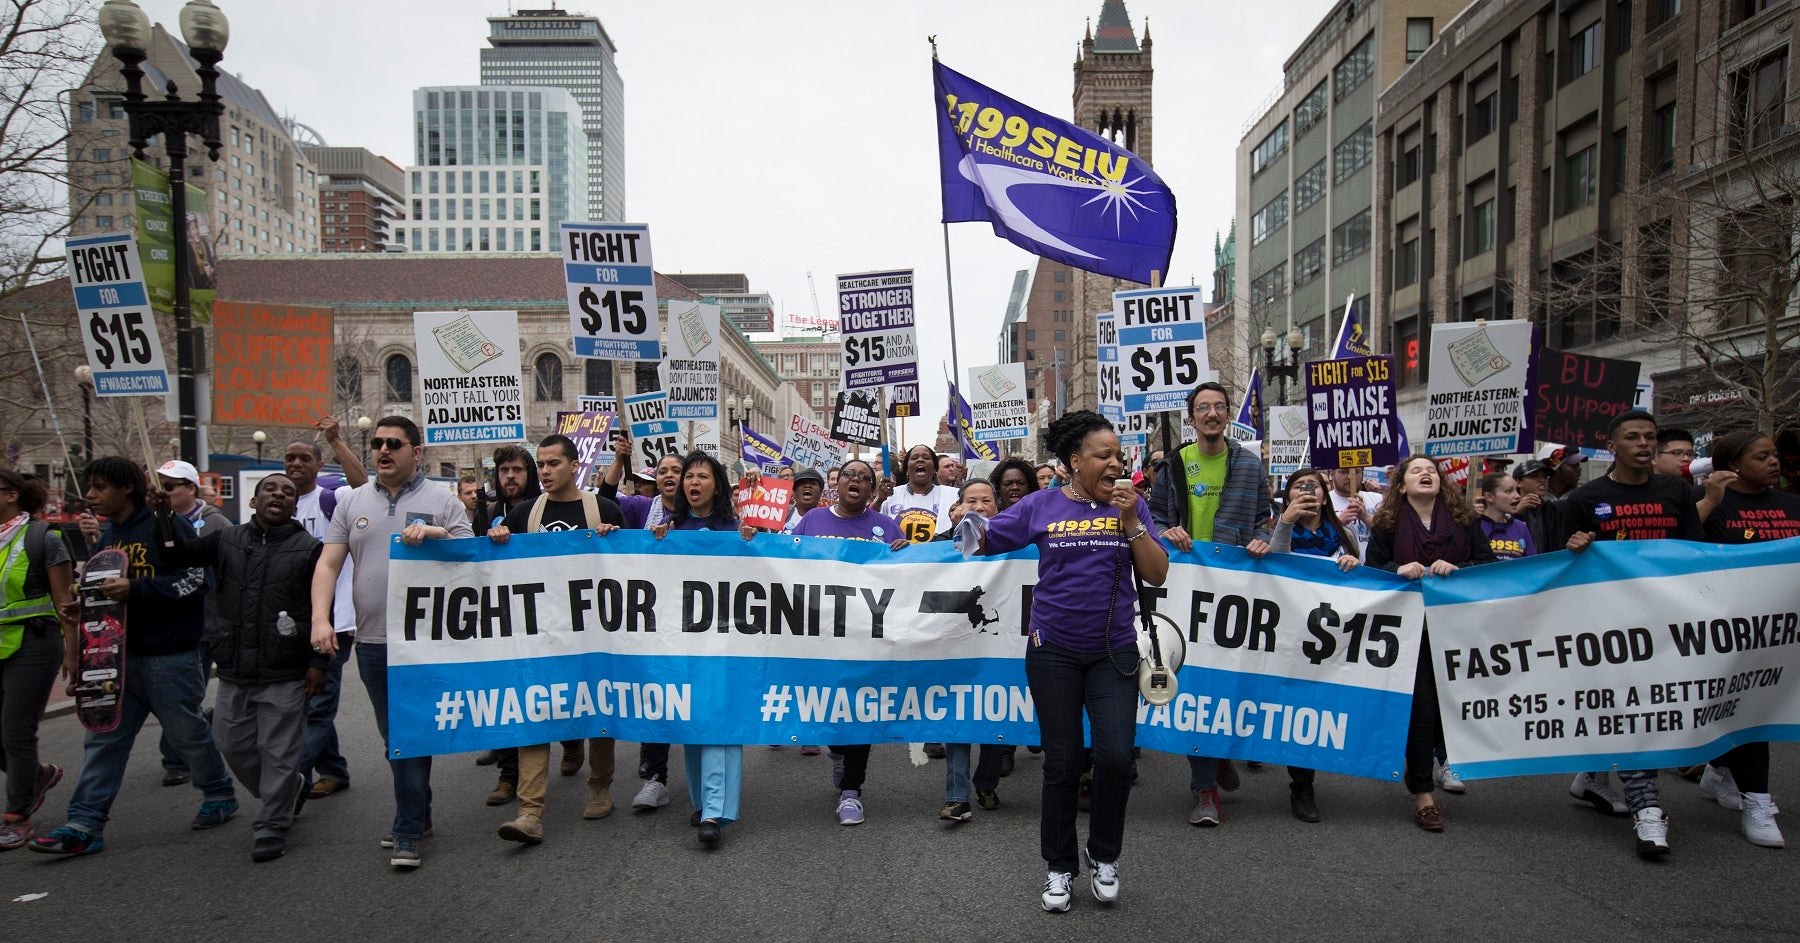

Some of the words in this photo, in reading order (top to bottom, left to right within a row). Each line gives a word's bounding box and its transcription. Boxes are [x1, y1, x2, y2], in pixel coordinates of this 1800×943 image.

[975, 138, 1044, 171] Healthcare
[1047, 160, 1098, 188] Workers
[145, 219, 168, 232] ONLY
[151, 248, 169, 260] ONE
[569, 232, 640, 263] FIGHT
[72, 244, 131, 283] FIGHT
[596, 268, 618, 282] FOR
[840, 279, 879, 290] HEALTHCARE
[881, 276, 912, 286] WORKERS
[99, 287, 120, 304] FOR
[841, 288, 912, 311] STRONGER
[214, 301, 245, 328] BU
[578, 287, 647, 336] $15
[789, 314, 807, 324] The
[842, 307, 914, 331] TOGETHER
[1124, 295, 1194, 325] FIGHT
[90, 312, 152, 369] $15
[1099, 321, 1117, 344] FIGH
[1151, 328, 1173, 341] FOR
[215, 332, 331, 368] SUPPORT
[593, 348, 640, 359] #WAGEACTION
[595, 339, 637, 350] #FIGHTFOR15
[845, 336, 885, 366] $15
[886, 335, 902, 347] AND
[905, 334, 911, 344] A
[886, 346, 914, 358] UNION
[669, 359, 717, 371] NORTHEASTERN:
[1131, 345, 1198, 391] $15
[1311, 361, 1348, 386] FIGHT
[1351, 367, 1363, 377] FOR
[1366, 359, 1389, 383] $15
[1561, 353, 1605, 388] BU
[100, 376, 163, 391] #WAGEACTION
[215, 367, 266, 390] LOW
[271, 370, 329, 392] WAGE
[424, 375, 518, 390] NORTHEASTERN:
[669, 373, 688, 384] DON'T
[690, 373, 702, 384] FAIL
[704, 373, 717, 384] YOUR
[1100, 364, 1121, 402] $15
[425, 391, 458, 405] DON'T
[463, 390, 488, 404] FAIL
[492, 389, 520, 402] YOUR
[669, 387, 717, 402] ADJUNCTS!
[891, 385, 918, 403] MERICA
[1146, 391, 1188, 402] #FIGHTFOR15
[1333, 386, 1390, 419] RAISE
[1431, 387, 1520, 406] NORTHEASTERN:
[1536, 384, 1630, 419] Support
[217, 393, 326, 425] WORKERS
[427, 405, 521, 424] ADJUNCTS!
[629, 400, 666, 422] LUCH
[672, 405, 714, 416] #WAGEACTION
[839, 405, 868, 423] JOBS
[973, 400, 1025, 410] NORTHEASTERN:
[974, 410, 992, 418] DON'T
[995, 409, 1008, 417] FAIL
[1011, 407, 1025, 415] YOUR
[1144, 400, 1186, 410] #WAGEACTIO
[1313, 402, 1327, 411] AND
[1429, 405, 1460, 420] DON'T
[1464, 403, 1488, 417] FAIL
[1493, 401, 1519, 414] YOUR
[558, 414, 584, 434] FIGHT
[590, 414, 610, 434] $15
[649, 423, 663, 433] POR
[791, 414, 810, 435] BU
[837, 419, 880, 440] JUSTICE
[975, 416, 1026, 430] ADJUNCTS!
[1428, 416, 1517, 439] ADJUNCTS!
[434, 426, 516, 441] #WAGEACTION
[978, 427, 1024, 439] #WAGEACTION
[1316, 418, 1391, 449] AMERICA
[793, 432, 821, 451] STAND
[823, 442, 840, 454] WITH
[1431, 438, 1509, 455] #WAGEACTION
[784, 441, 823, 468] FIGHT
[901, 510, 920, 518] Home
[1616, 503, 1663, 516] BOSTON
[1739, 509, 1786, 519] BOSTON
[906, 523, 930, 542] 15
[1600, 519, 1619, 531] FAST
[1621, 518, 1643, 528] FOOD
[1726, 520, 1745, 528] FAST
[1748, 520, 1769, 528] FOOD
[1629, 529, 1667, 540] STRIKE
[404, 582, 545, 640] FIGHT
[568, 578, 657, 633] FOR
[681, 580, 895, 639] DIGNITY
[1189, 589, 1281, 652] FOR
[1302, 602, 1402, 669] $15
[1445, 628, 1654, 681] FAST-FOOD
[1462, 699, 1499, 720] FOR
[1509, 693, 1547, 718] $15
[1574, 688, 1615, 711] FOR
[1626, 686, 1640, 707] A
[1651, 678, 1724, 705] BETTER
[1727, 666, 1783, 696] BOSTON
[435, 679, 692, 731] #WAGEACTION
[760, 684, 1034, 723] #WAGEACTION
[1136, 691, 1348, 751] WAGEACTION
[1525, 719, 1564, 740] FOR
[1575, 717, 1588, 737] A
[1599, 709, 1683, 736] BETTER
[1693, 698, 1740, 728] FUTURE
